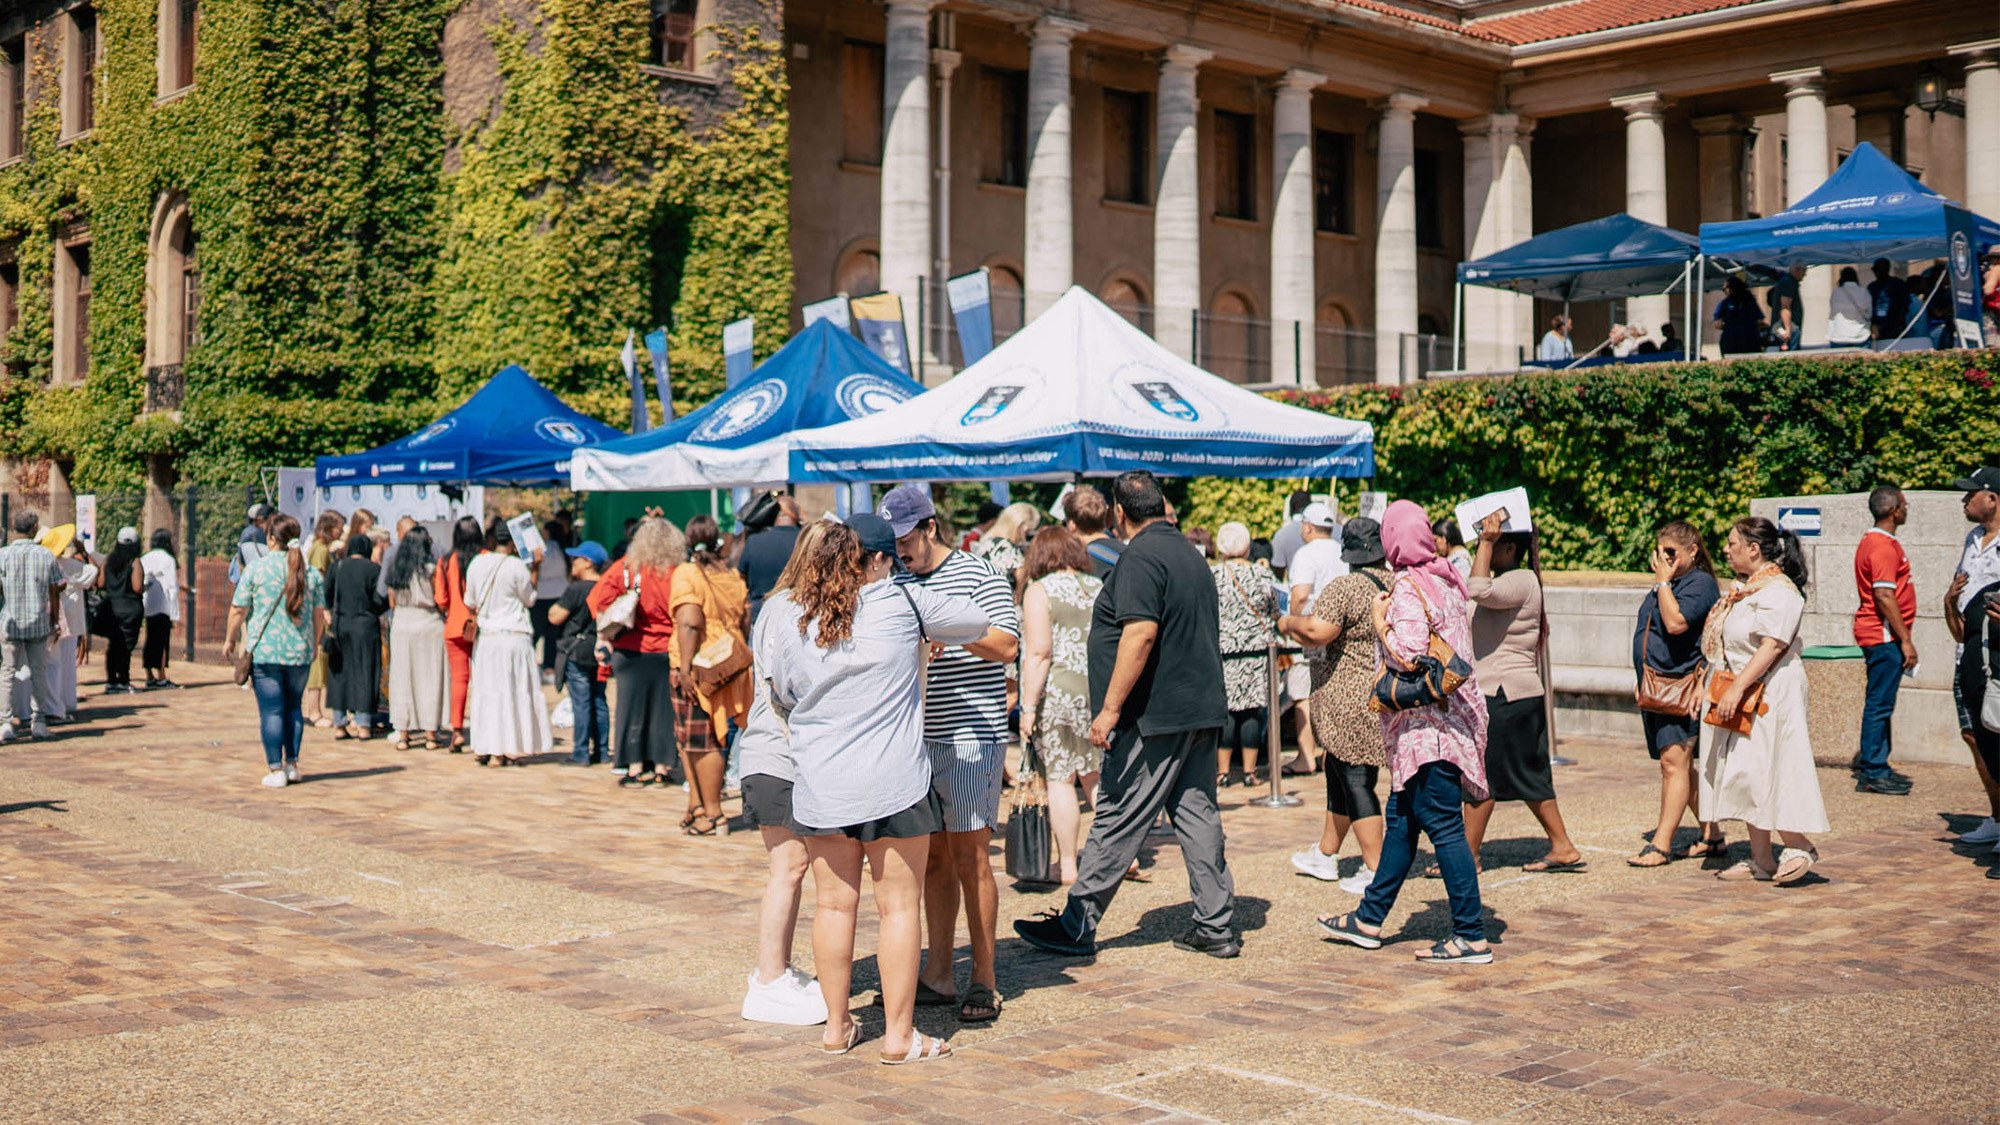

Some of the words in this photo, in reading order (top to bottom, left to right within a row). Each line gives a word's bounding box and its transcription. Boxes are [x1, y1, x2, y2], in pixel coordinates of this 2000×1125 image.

[1773, 221, 1879, 236] www.humanities.uct.ac.za
[1206, 453, 1233, 466] human
[1233, 455, 1268, 467] potential
